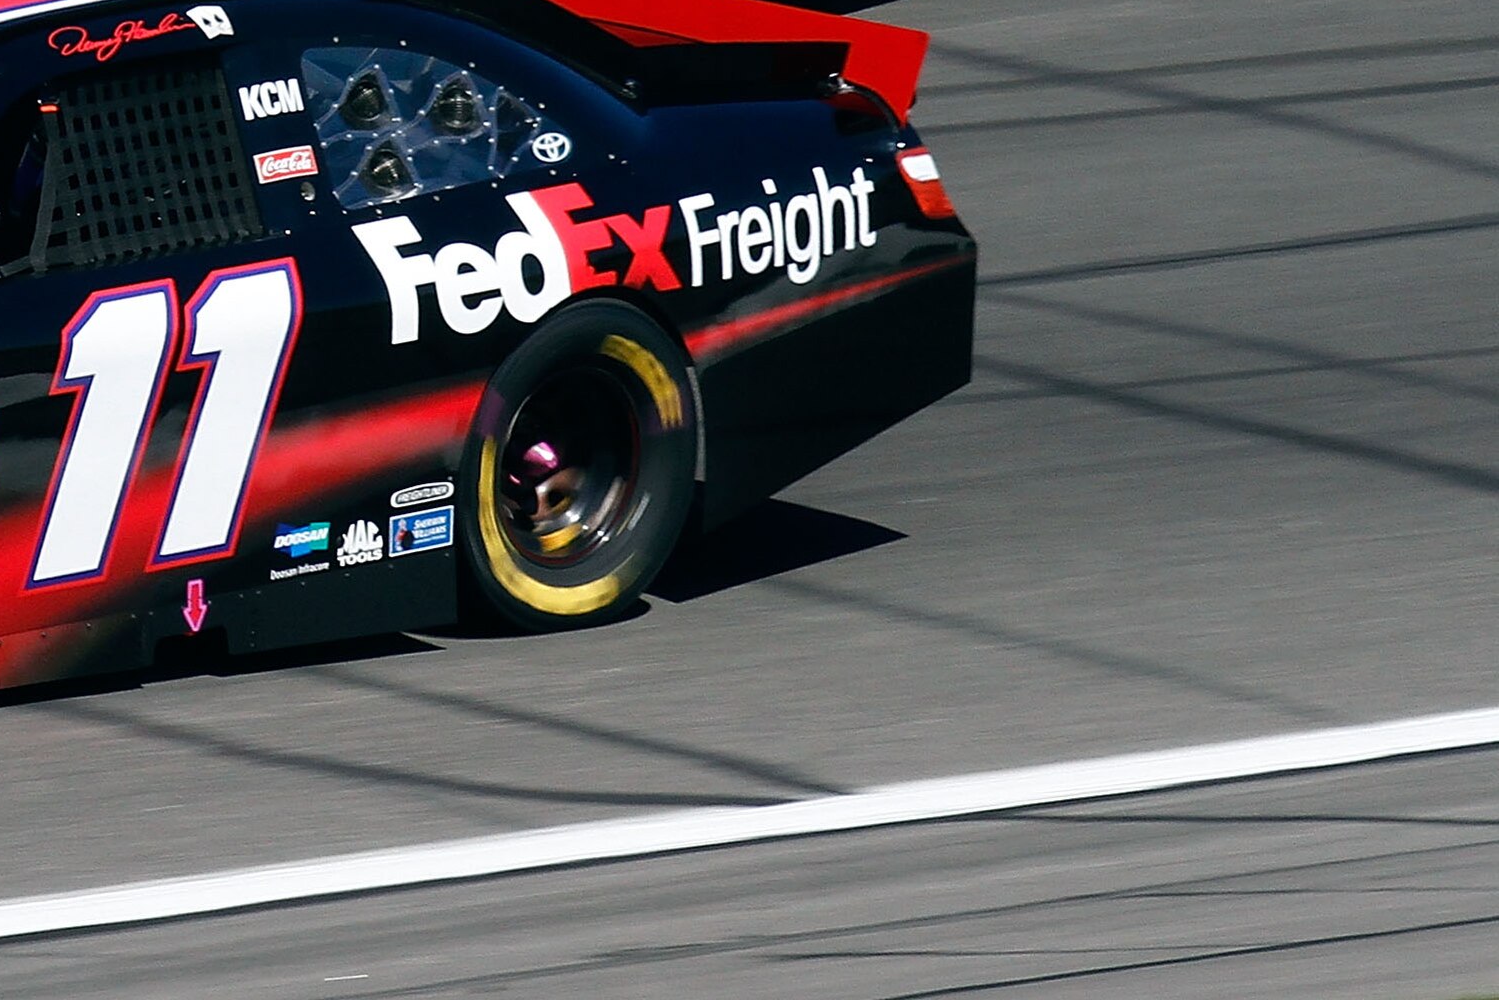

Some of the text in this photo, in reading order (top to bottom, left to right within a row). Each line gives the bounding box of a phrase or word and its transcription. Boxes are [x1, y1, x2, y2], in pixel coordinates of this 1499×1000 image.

[238, 78, 304, 121] KCM
[350, 166, 878, 345] FedEx Freight
[20, 255, 305, 596] 11
[274, 527, 329, 548] DOOSAN
[337, 549, 383, 567] TOOLS
